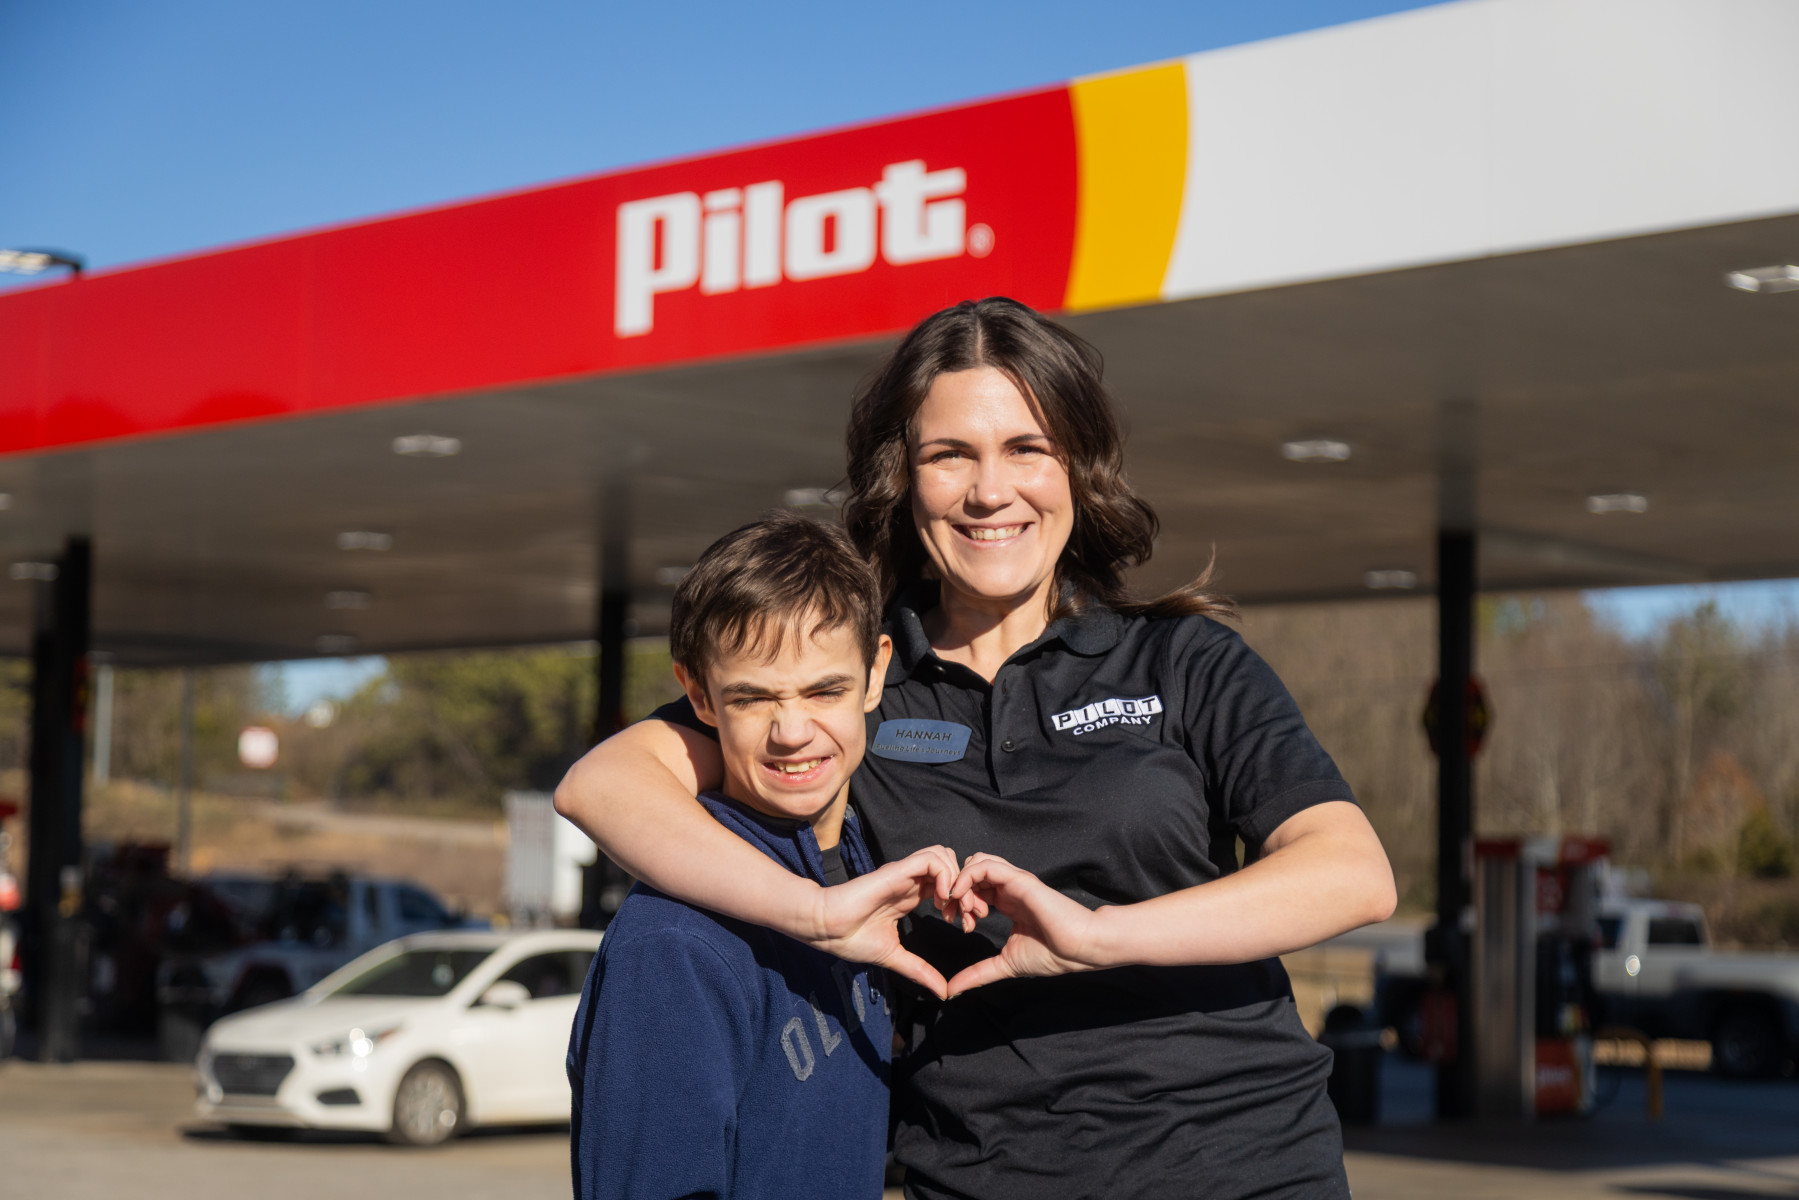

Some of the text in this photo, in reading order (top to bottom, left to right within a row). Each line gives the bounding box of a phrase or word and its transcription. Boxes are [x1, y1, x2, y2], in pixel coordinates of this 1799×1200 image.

[1054, 697, 1160, 729] PILOT
[1073, 716, 1152, 735] COMPANY
[895, 729, 952, 742] HANNAH
[906, 745, 924, 753] Lifes
